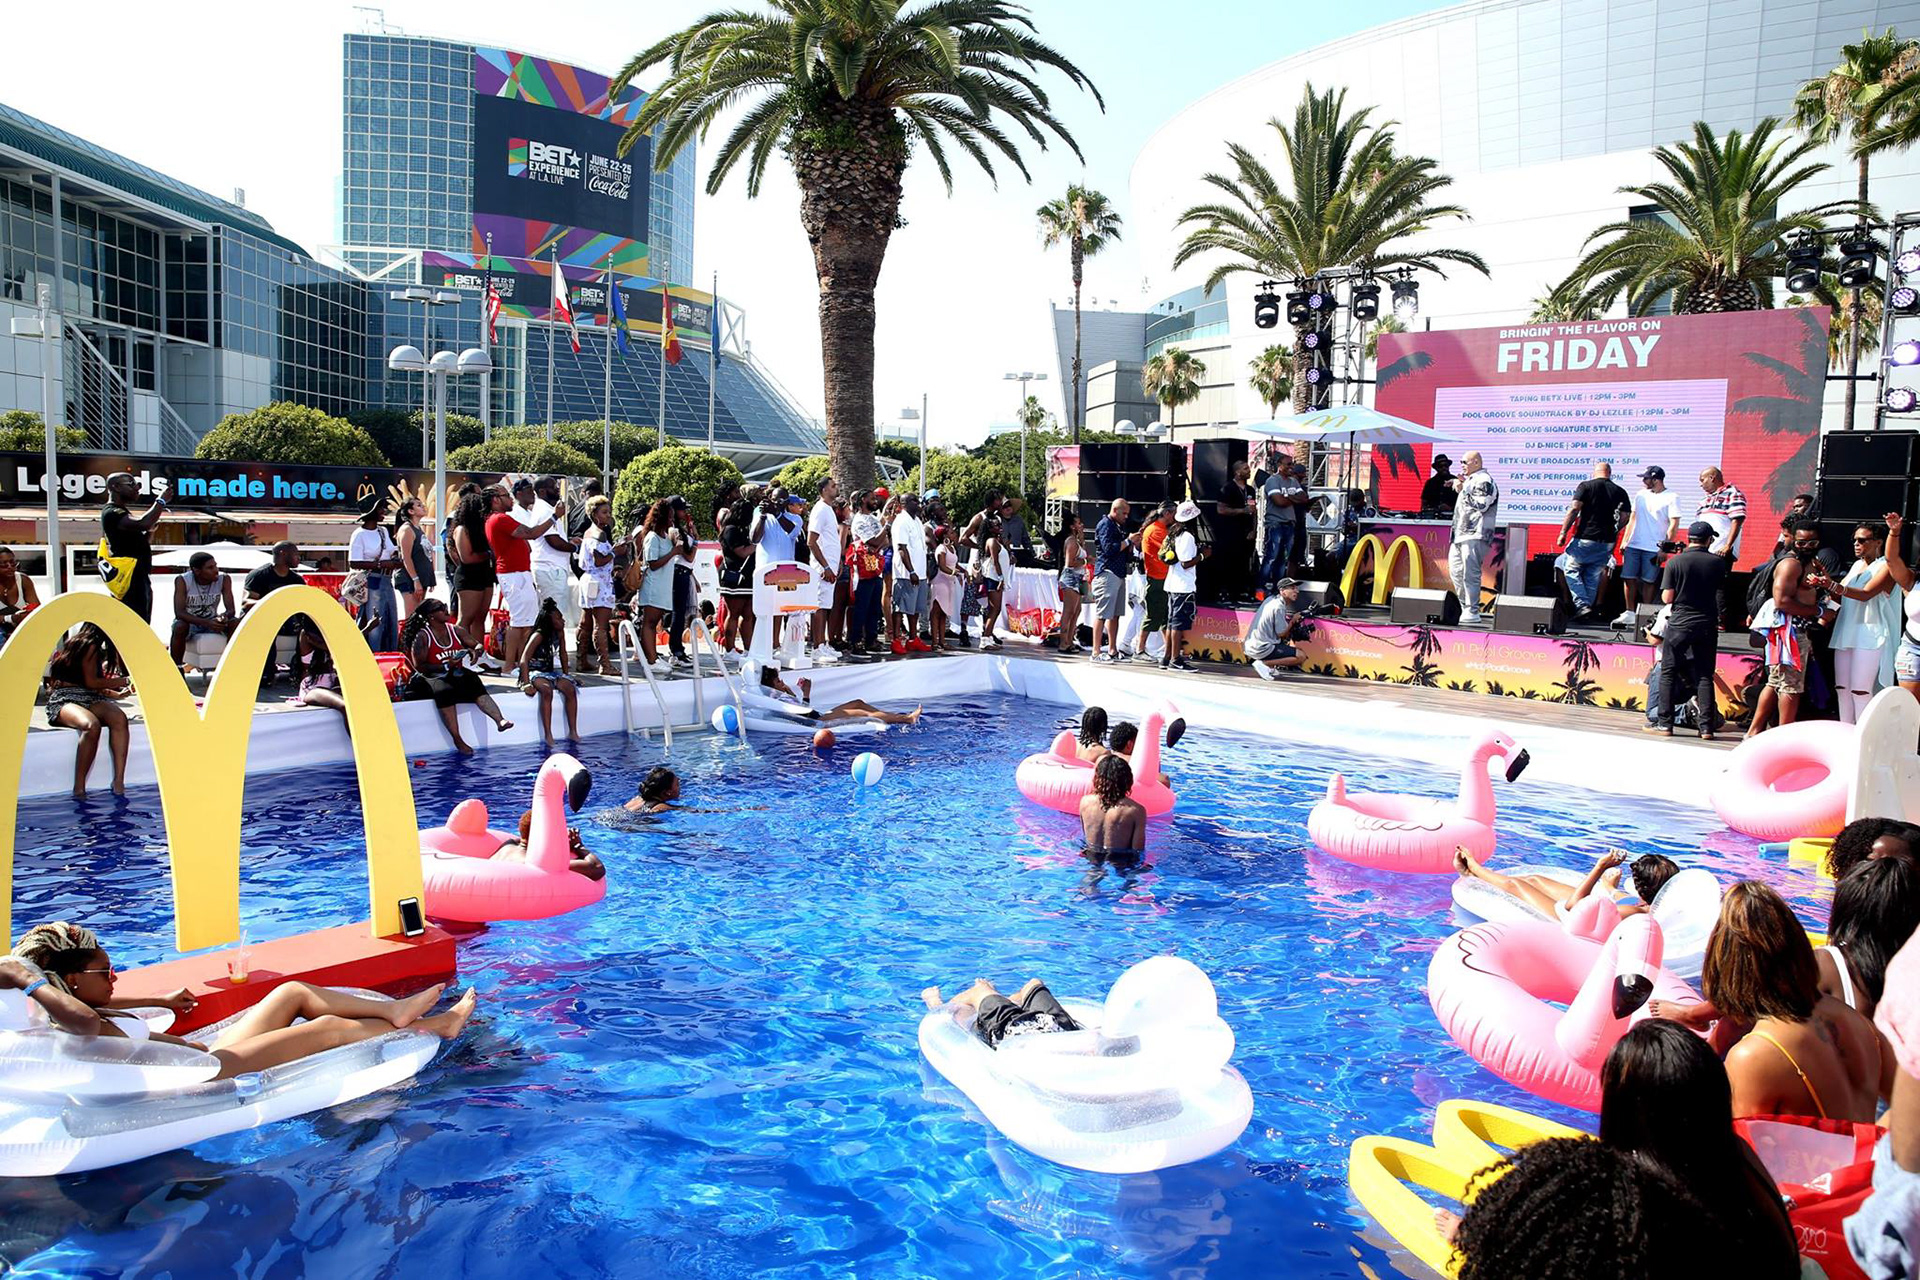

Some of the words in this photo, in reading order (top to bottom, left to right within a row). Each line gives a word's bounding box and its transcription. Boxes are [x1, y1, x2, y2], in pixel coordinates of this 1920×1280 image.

[529, 140, 573, 167] BET
[529, 160, 580, 179] EXPERIENCE
[589, 154, 608, 168] JUNE
[610, 160, 632, 174] 22-25
[528, 171, 537, 181] AT
[551, 175, 564, 186] LIVE
[588, 164, 621, 181] PRESENTED
[622, 174, 631, 183] BY
[455, 274, 478, 286] BET
[580, 287, 601, 299] BET
[1500, 327, 1554, 339] BRINGIN'
[1557, 325, 1582, 336] THE
[1586, 322, 1637, 335] FLAVOR
[1641, 320, 1661, 331] ON
[1497, 335, 1661, 373] FRIDAY
[1462, 411, 1482, 419] POOL
[1484, 410, 1516, 418] GROOVE
[1518, 410, 1573, 418] SOUNDTRACK
[1575, 409, 1587, 417] BY
[1589, 409, 1600, 417] DJ
[1641, 408, 1664, 416] 12PM
[1487, 426, 1507, 434] POOL
[1544, 425, 1591, 433] SIGNATURE
[1592, 425, 1620, 433] STYLE
[1537, 441, 1565, 449] D-NICE
[1570, 441, 1588, 449] 3PM
[1540, 457, 1591, 465] BROADCAST
[1543, 473, 1588, 481] PERFORMS
[177, 474, 266, 498] made
[273, 475, 345, 500] here.
[1530, 504, 1564, 512] GROOVE
[1330, 629, 1352, 643] Pool
[1468, 643, 1496, 660] Pool
[1498, 646, 1548, 662] Groove
